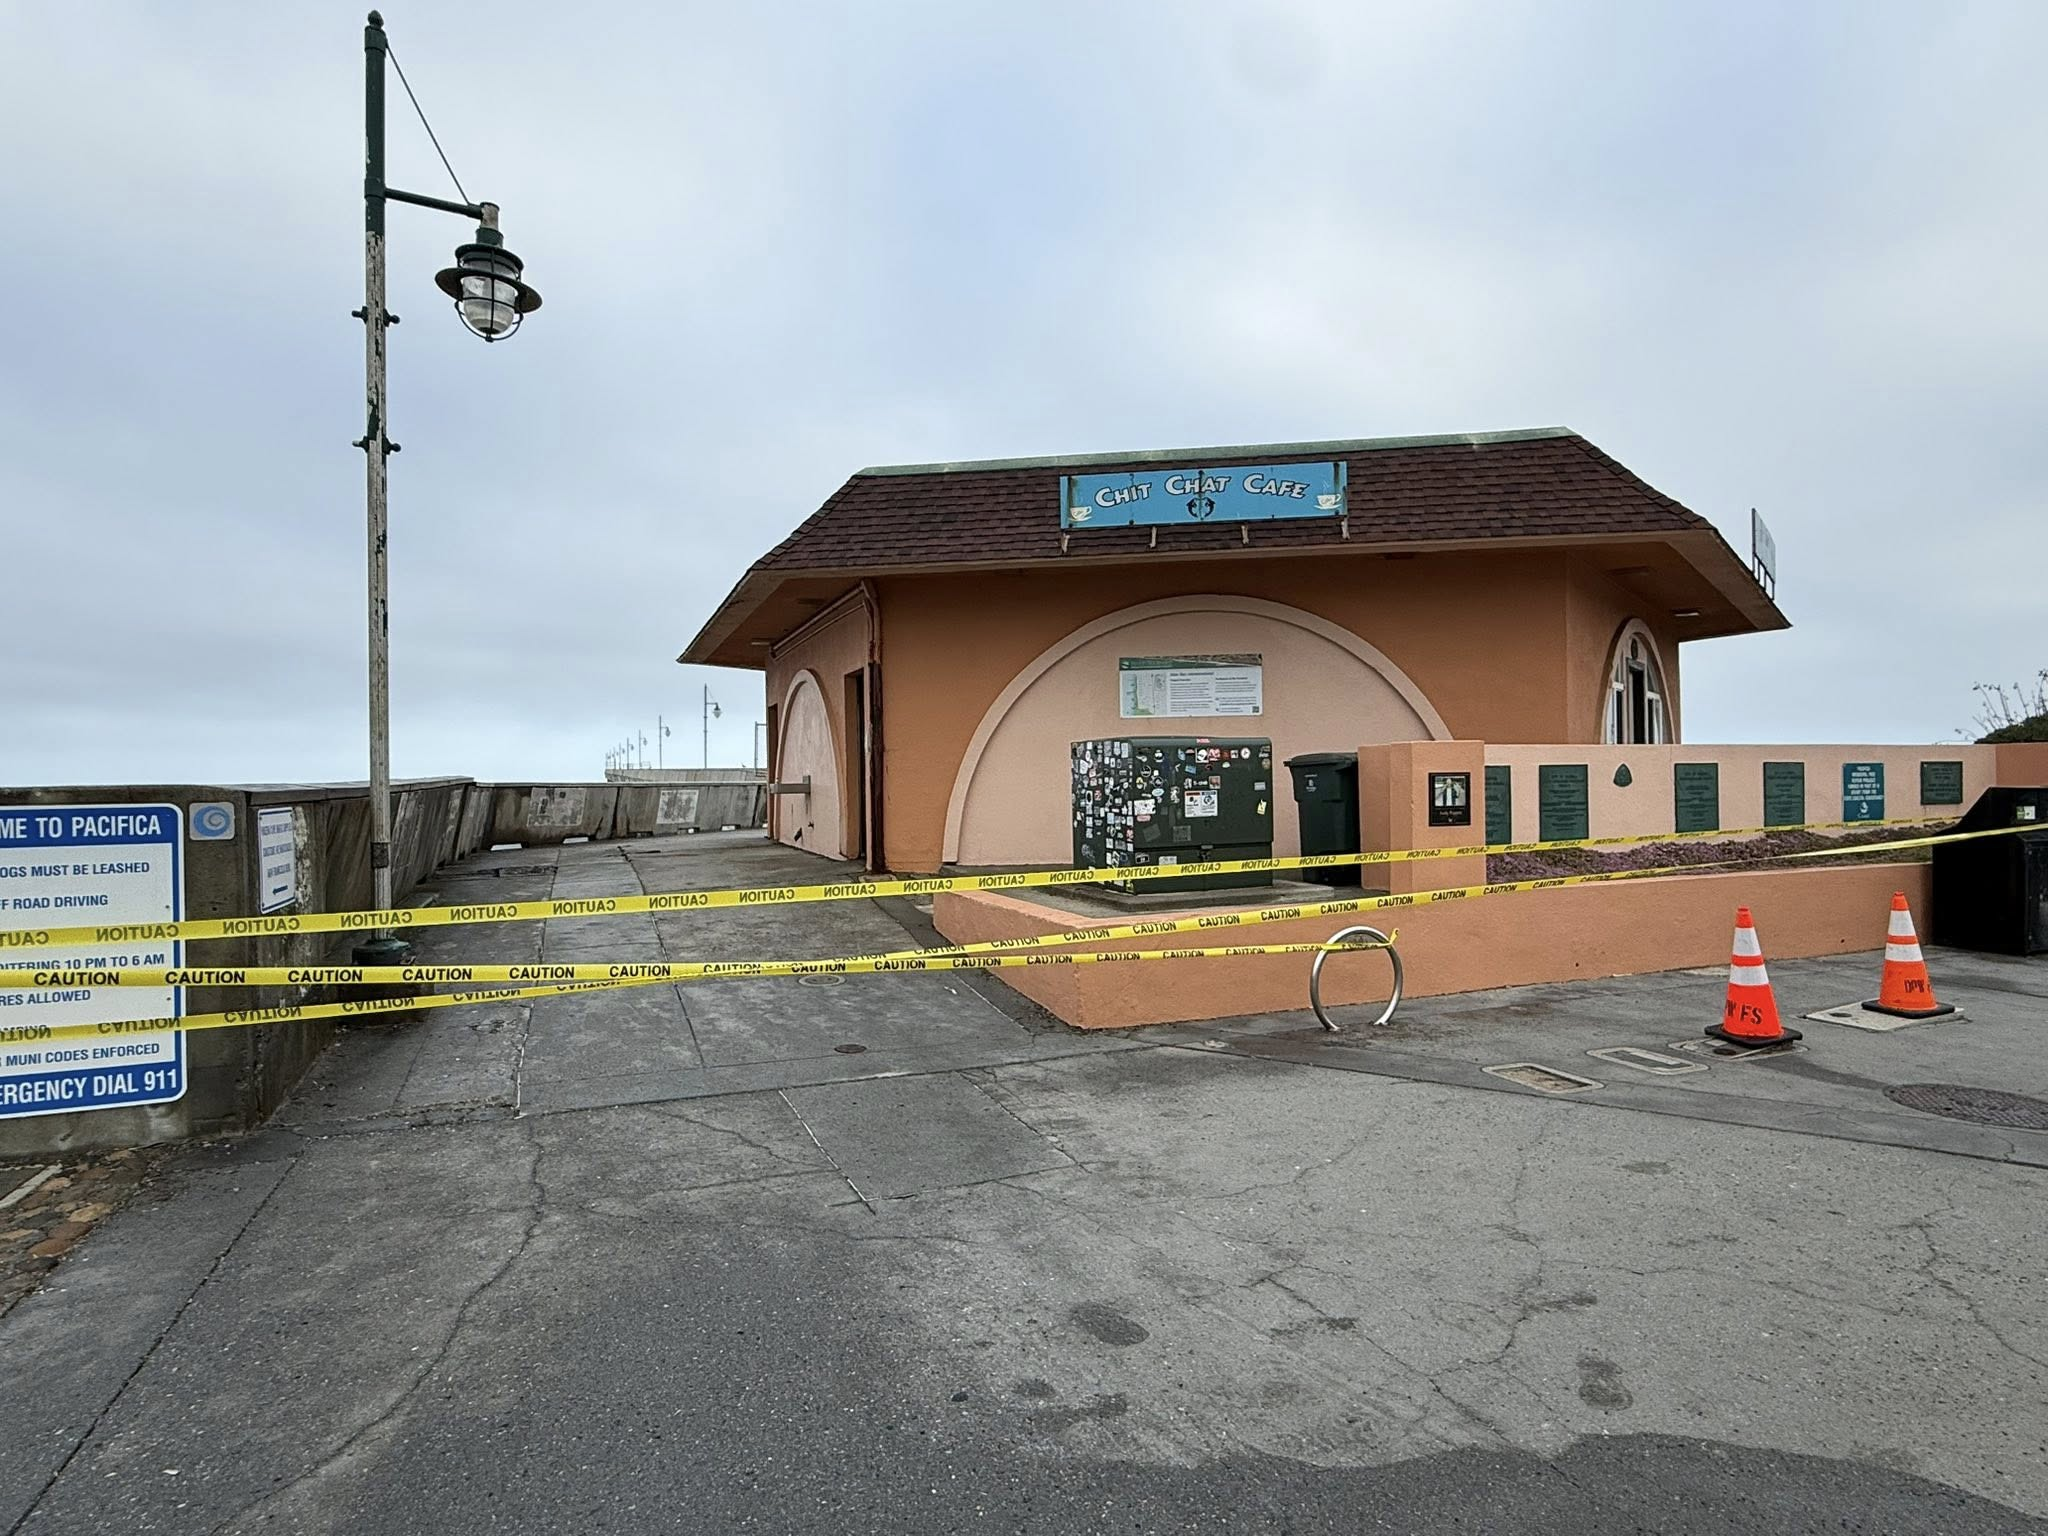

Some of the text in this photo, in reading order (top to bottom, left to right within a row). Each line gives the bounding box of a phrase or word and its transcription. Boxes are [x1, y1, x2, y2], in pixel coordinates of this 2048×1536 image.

[1095, 473, 1310, 507] CHIT CHAT CAFE
[35, 817, 63, 838] TO
[71, 815, 161, 837] PACIFICA
[31, 864, 69, 877] MUST
[72, 863, 89, 875] BE
[93, 862, 150, 875] LEASHED
[13, 897, 50, 909] ROAD
[54, 894, 108, 907] DRIVING
[991, 937, 1040, 948] CAUTION
[1063, 929, 1110, 941] CAUTION
[1132, 922, 1177, 934] CAUTION
[1198, 915, 1240, 927] CAUTION
[1260, 908, 1300, 921] CAUTION
[1320, 902, 1359, 914] CAUTION
[1377, 896, 1413, 908] CAUTION
[1431, 890, 1466, 901] CAUTION
[1483, 885, 1517, 895] CAUTION
[1532, 880, 1565, 889] CAUTION
[34, 971, 120, 986] CAUTION
[165, 970, 245, 984] CAUTION
[288, 969, 363, 982] CAUTION
[402, 968, 472, 981] CAUTION
[509, 966, 575, 979] CAUTION
[609, 965, 671, 977] CAUTION
[703, 964, 761, 974] CAUTION
[874, 960, 926, 970] CAUTION
[952, 957, 1001, 968] CAUTION
[1026, 955, 1073, 965] CAUTION
[1097, 952, 1141, 962] CAUTION
[1162, 950, 1205, 959] CAUTION
[65, 959, 81, 969] 10
[85, 957, 106, 968] PM
[110, 956, 128, 967] TO
[132, 955, 140, 965] 6
[143, 954, 165, 965] AM
[27, 989, 91, 1005] ALLOWED
[6, 1053, 41, 1066] MUNI
[45, 1050, 88, 1063] CODES
[93, 1043, 160, 1059] ENFORCED
[93, 1073, 138, 1097] DIAL
[144, 1069, 177, 1092] 911
